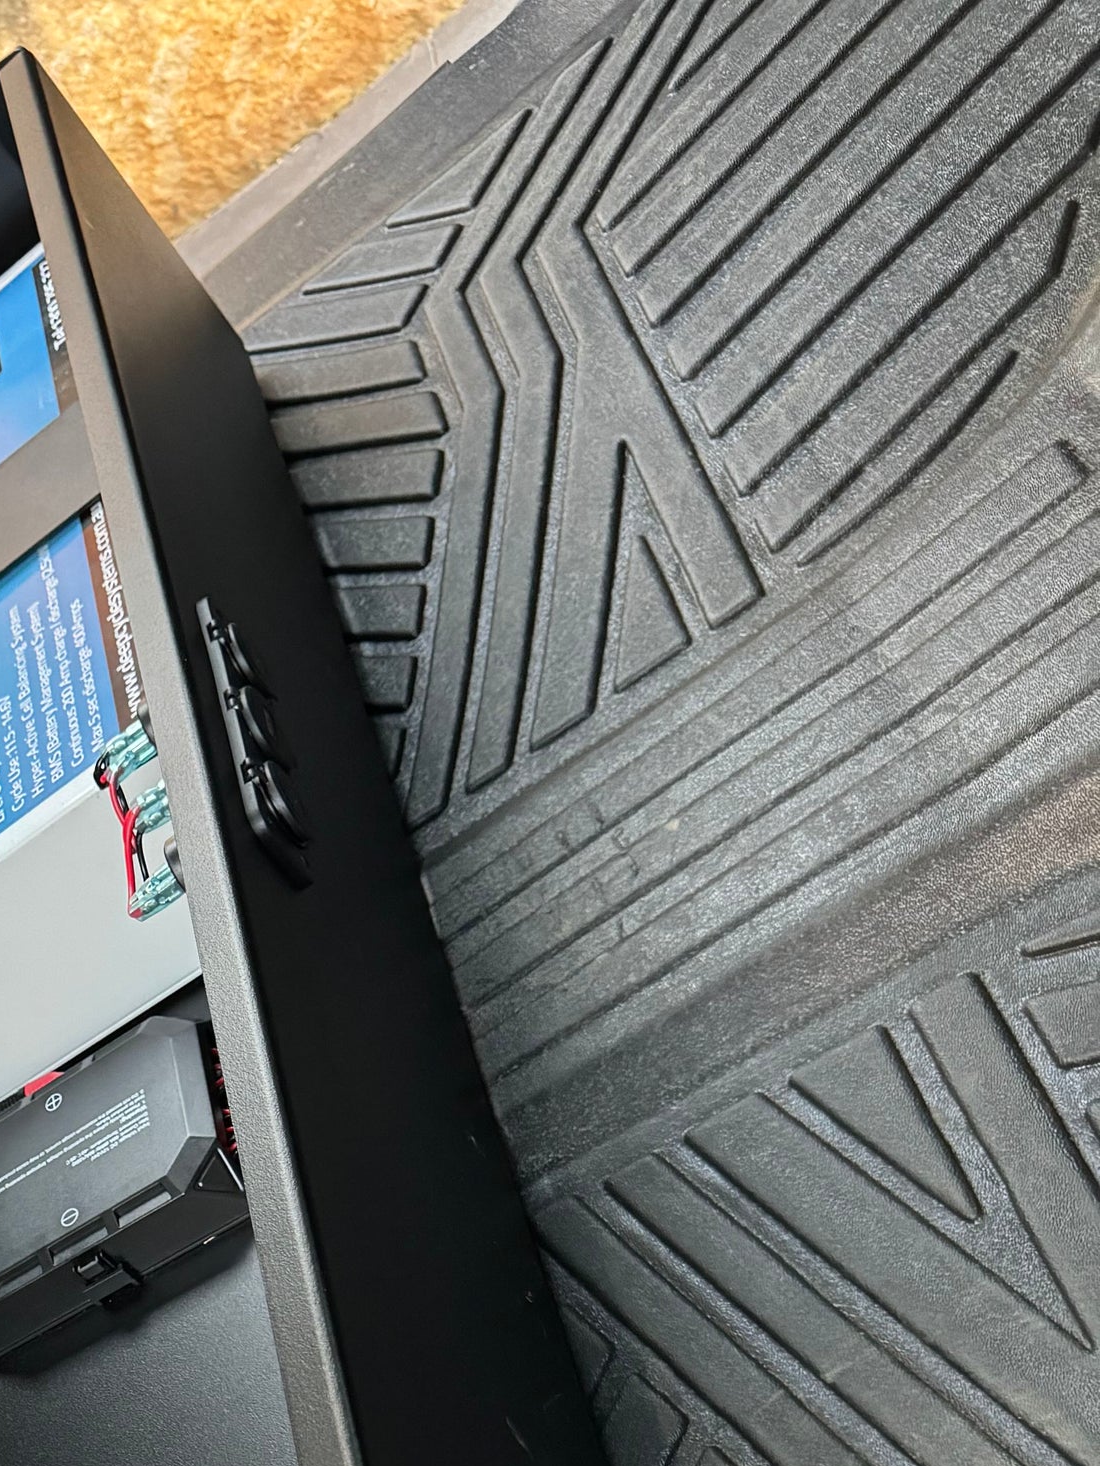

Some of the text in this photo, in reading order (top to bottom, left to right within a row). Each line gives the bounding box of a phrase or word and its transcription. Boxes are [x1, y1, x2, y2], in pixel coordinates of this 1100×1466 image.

[46, 576, 60, 621] discharge
[54, 626, 66, 660] charge
[34, 641, 52, 711] Management
[59, 660, 71, 687] Amp
[79, 646, 95, 695] discharge
[9, 606, 45, 796] Hyper-Active Cell Balancing System
[45, 708, 60, 753] (Battery
[67, 706, 83, 767] Continuous
[91, 722, 104, 752] Max
[49, 751, 63, 782] BMS
[10, 779, 25, 811] Cycle
